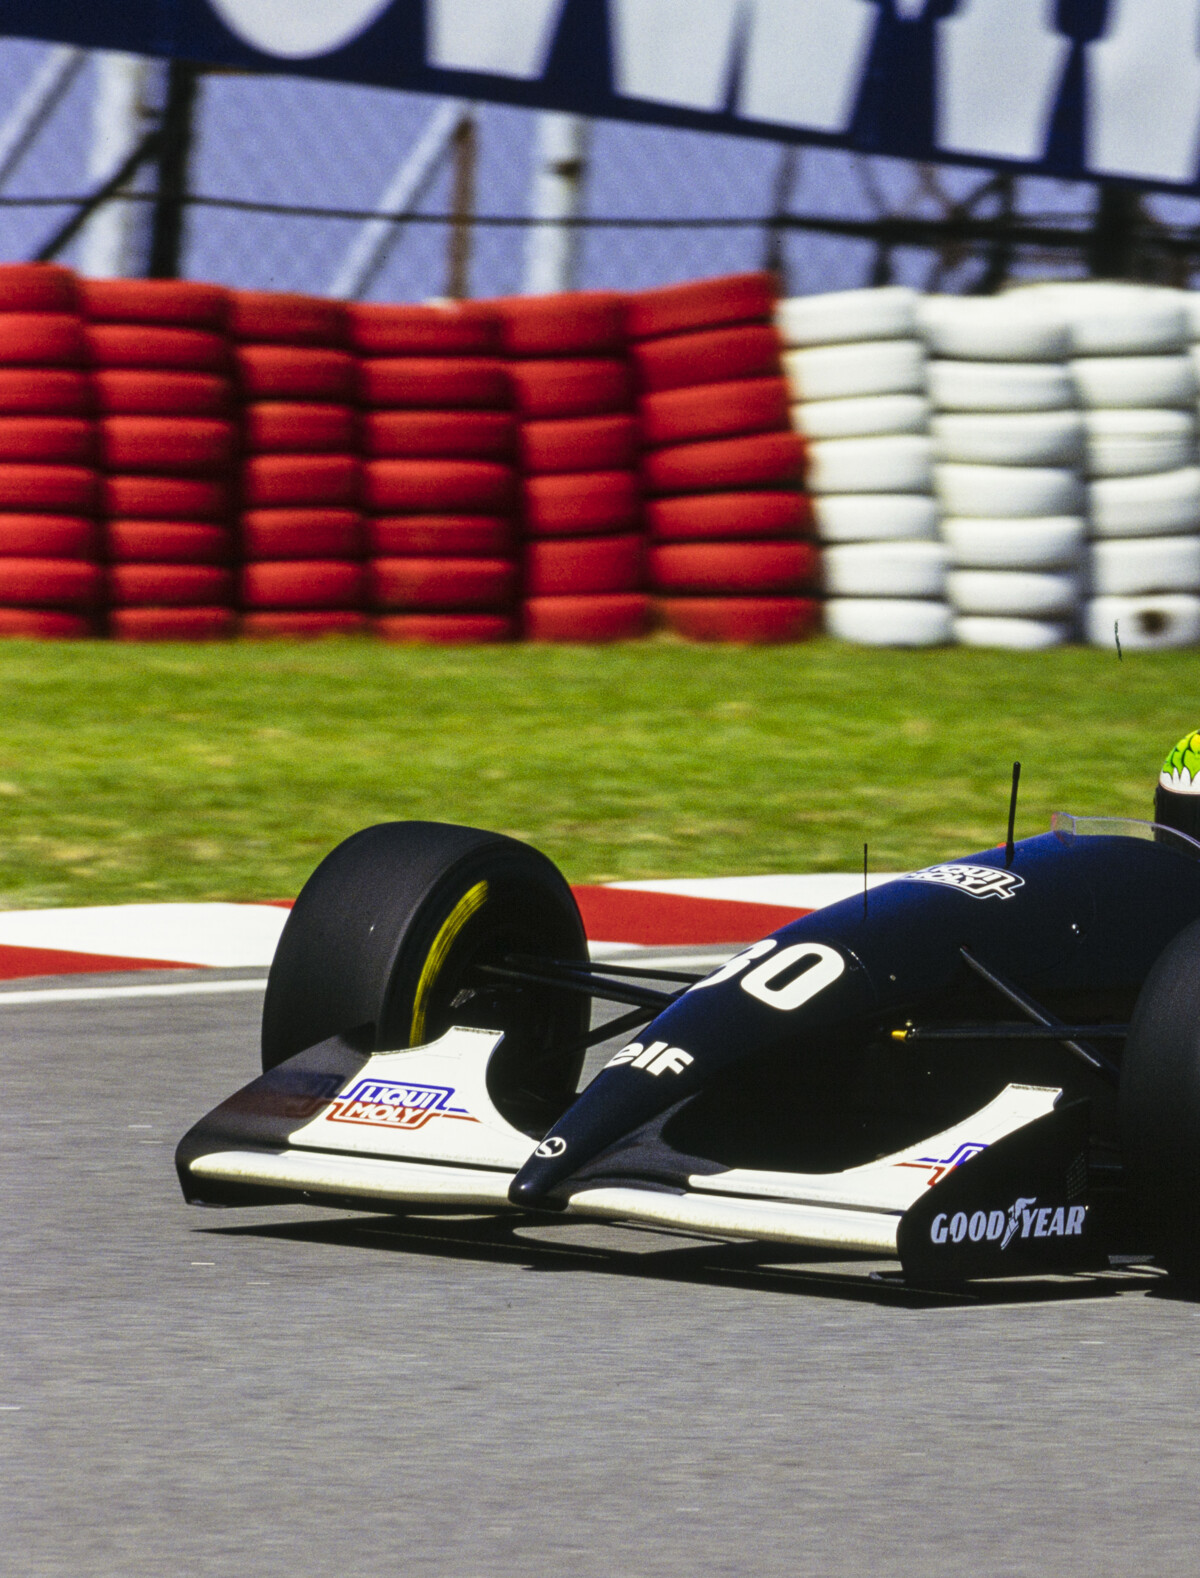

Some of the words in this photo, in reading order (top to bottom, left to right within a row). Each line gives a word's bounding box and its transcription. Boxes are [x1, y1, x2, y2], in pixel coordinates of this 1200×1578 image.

[603, 1040, 695, 1077] elf
[359, 1085, 437, 1109] LIQUI
[345, 1102, 425, 1124] MOLY
